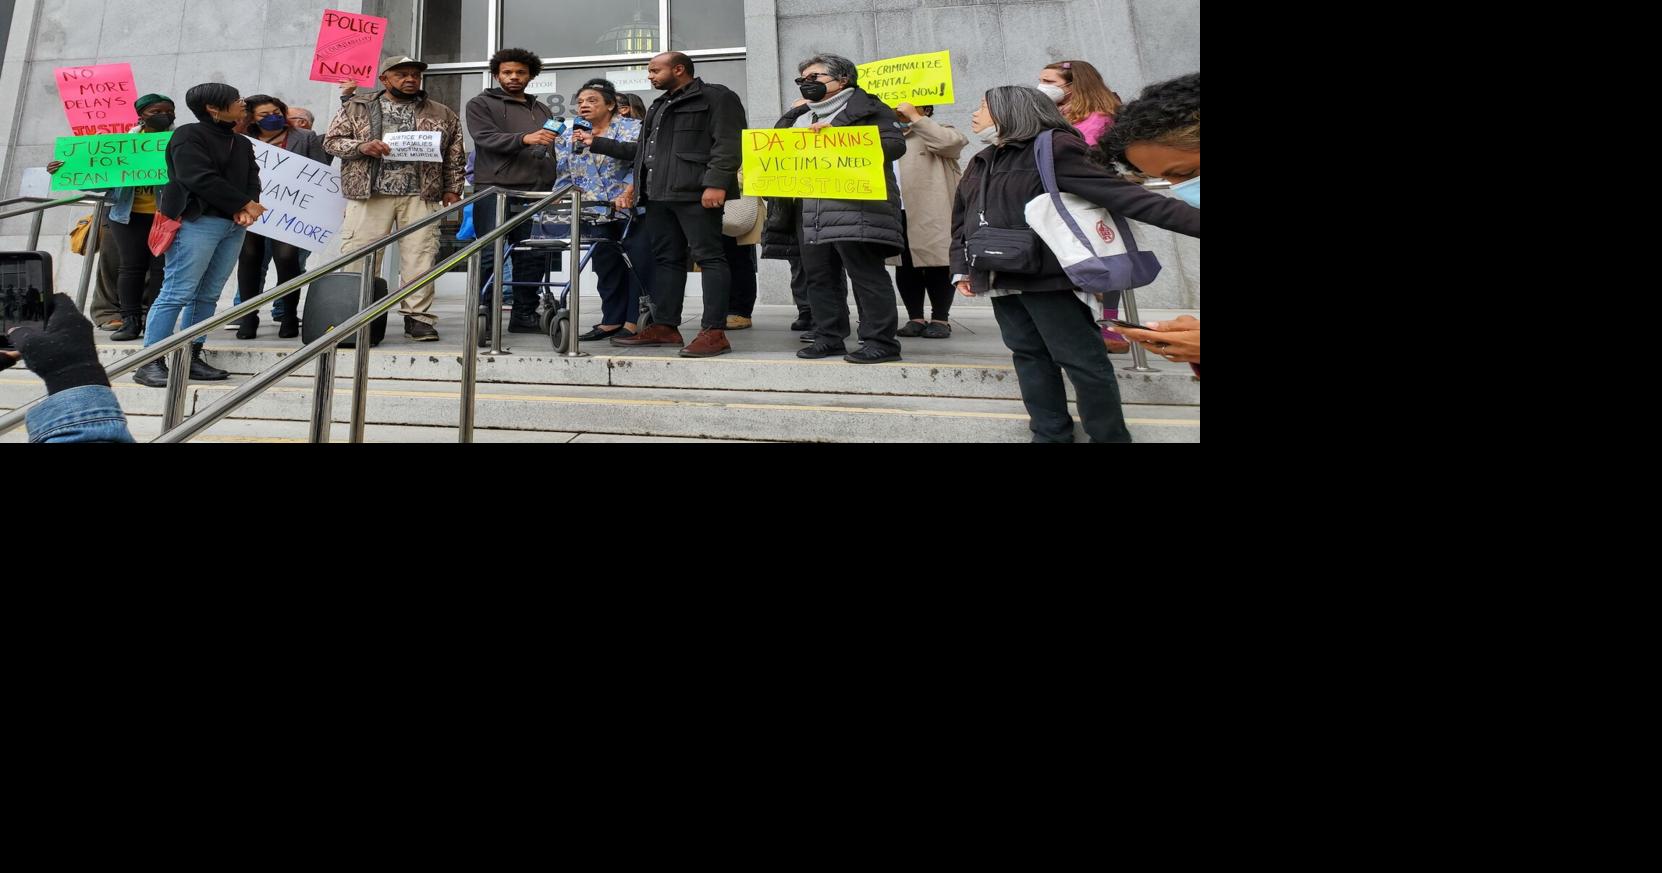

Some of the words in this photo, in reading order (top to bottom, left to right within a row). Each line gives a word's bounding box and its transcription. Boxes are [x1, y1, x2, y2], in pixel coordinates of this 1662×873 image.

[325, 13, 379, 35] POLICE
[62, 68, 94, 82] NO
[319, 61, 372, 78] NOW!
[79, 81, 129, 95] MORE
[867, 77, 911, 90] MENTAL
[877, 90, 907, 100] NESS
[911, 82, 945, 98] NOW!
[64, 96, 127, 110] DELAYS
[83, 110, 107, 120] TO
[72, 122, 137, 136] JUSTIC
[63, 138, 166, 157] JUSTICE
[750, 131, 784, 151] DA
[792, 131, 874, 150] JENKINS
[89, 156, 129, 167] FOR
[253, 145, 290, 171] AY
[296, 163, 341, 194] HIS
[759, 156, 832, 172] VICTIMS
[837, 156, 872, 169] NEED
[59, 172, 108, 186] SEAN
[121, 168, 168, 183] MOOR
[752, 175, 873, 196] JUSTICE
[276, 213, 333, 244] MOORE
